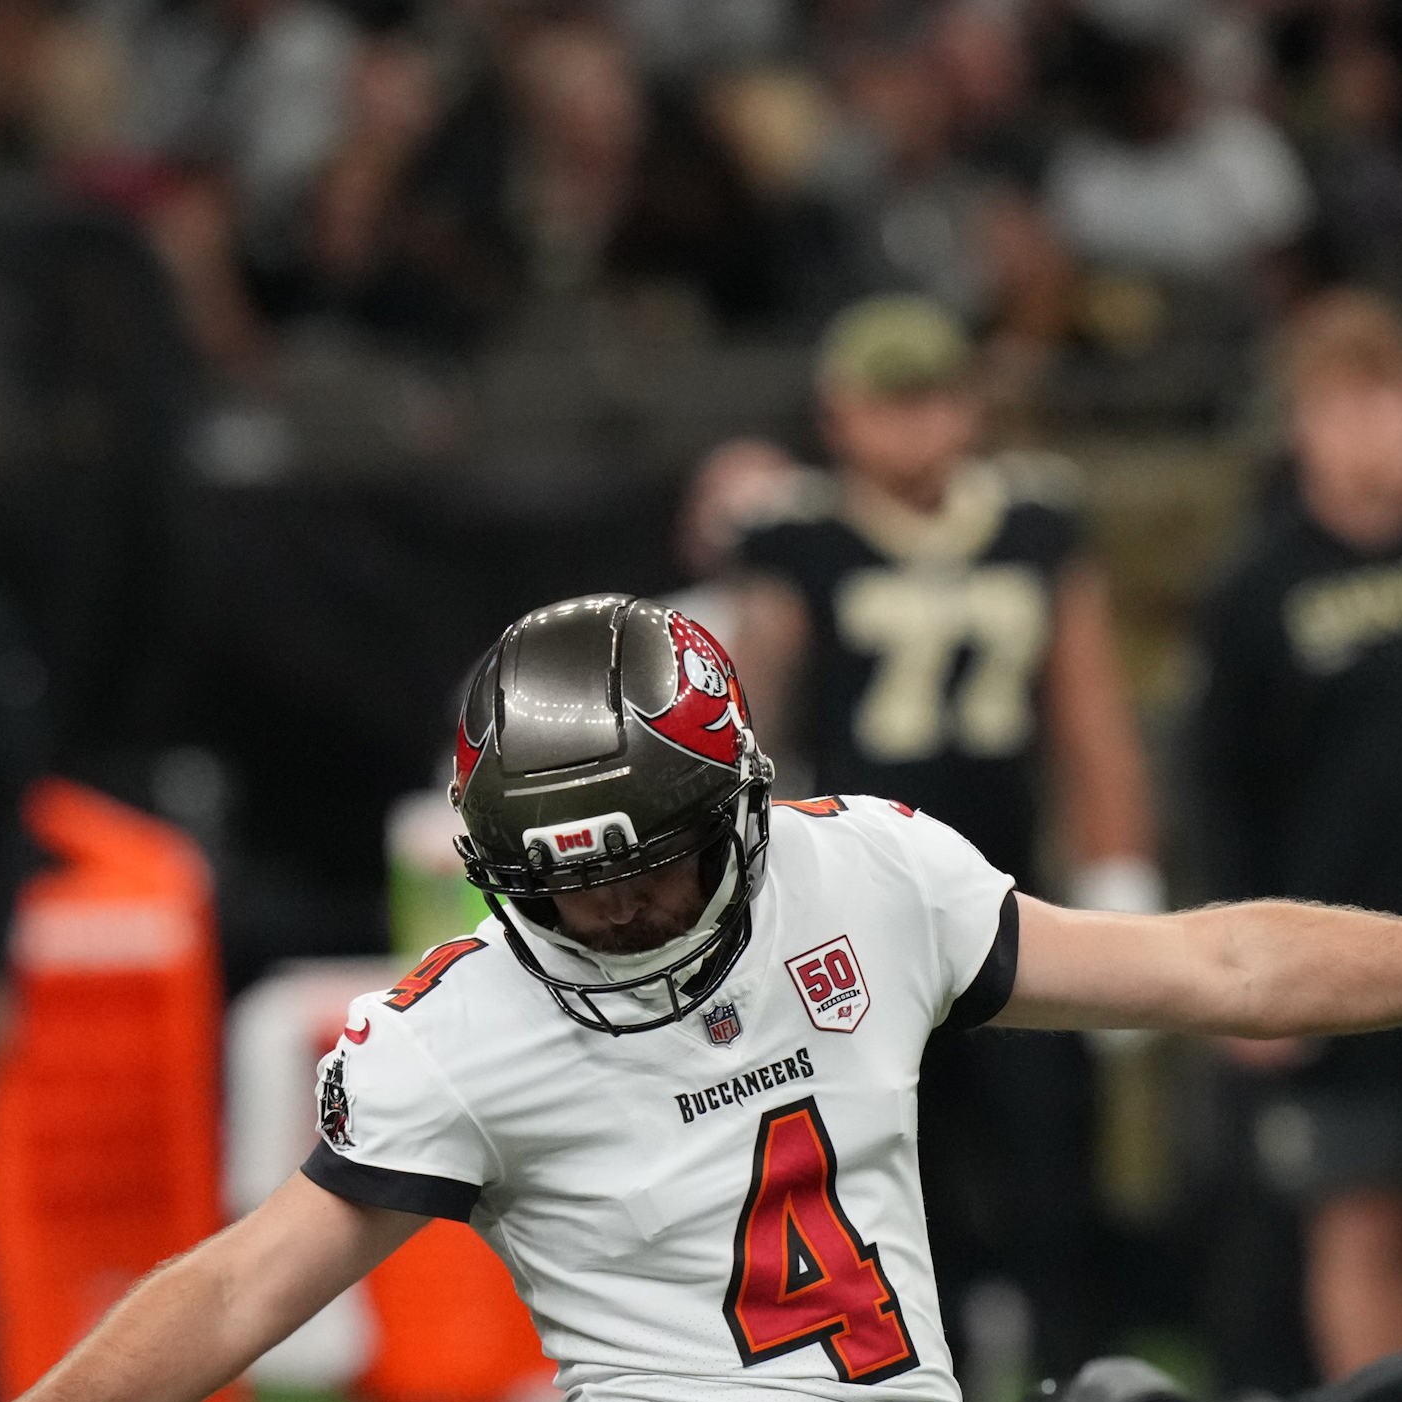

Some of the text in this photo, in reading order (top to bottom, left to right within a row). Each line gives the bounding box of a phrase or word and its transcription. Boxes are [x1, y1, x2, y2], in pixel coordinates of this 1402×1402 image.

[836, 570, 1047, 758] 77
[383, 937, 489, 1012] 4
[796, 948, 857, 1003] 50
[710, 1018, 738, 1042] NFL
[673, 1047, 815, 1124] BUCCANEERS
[722, 1095, 921, 1386] 4
